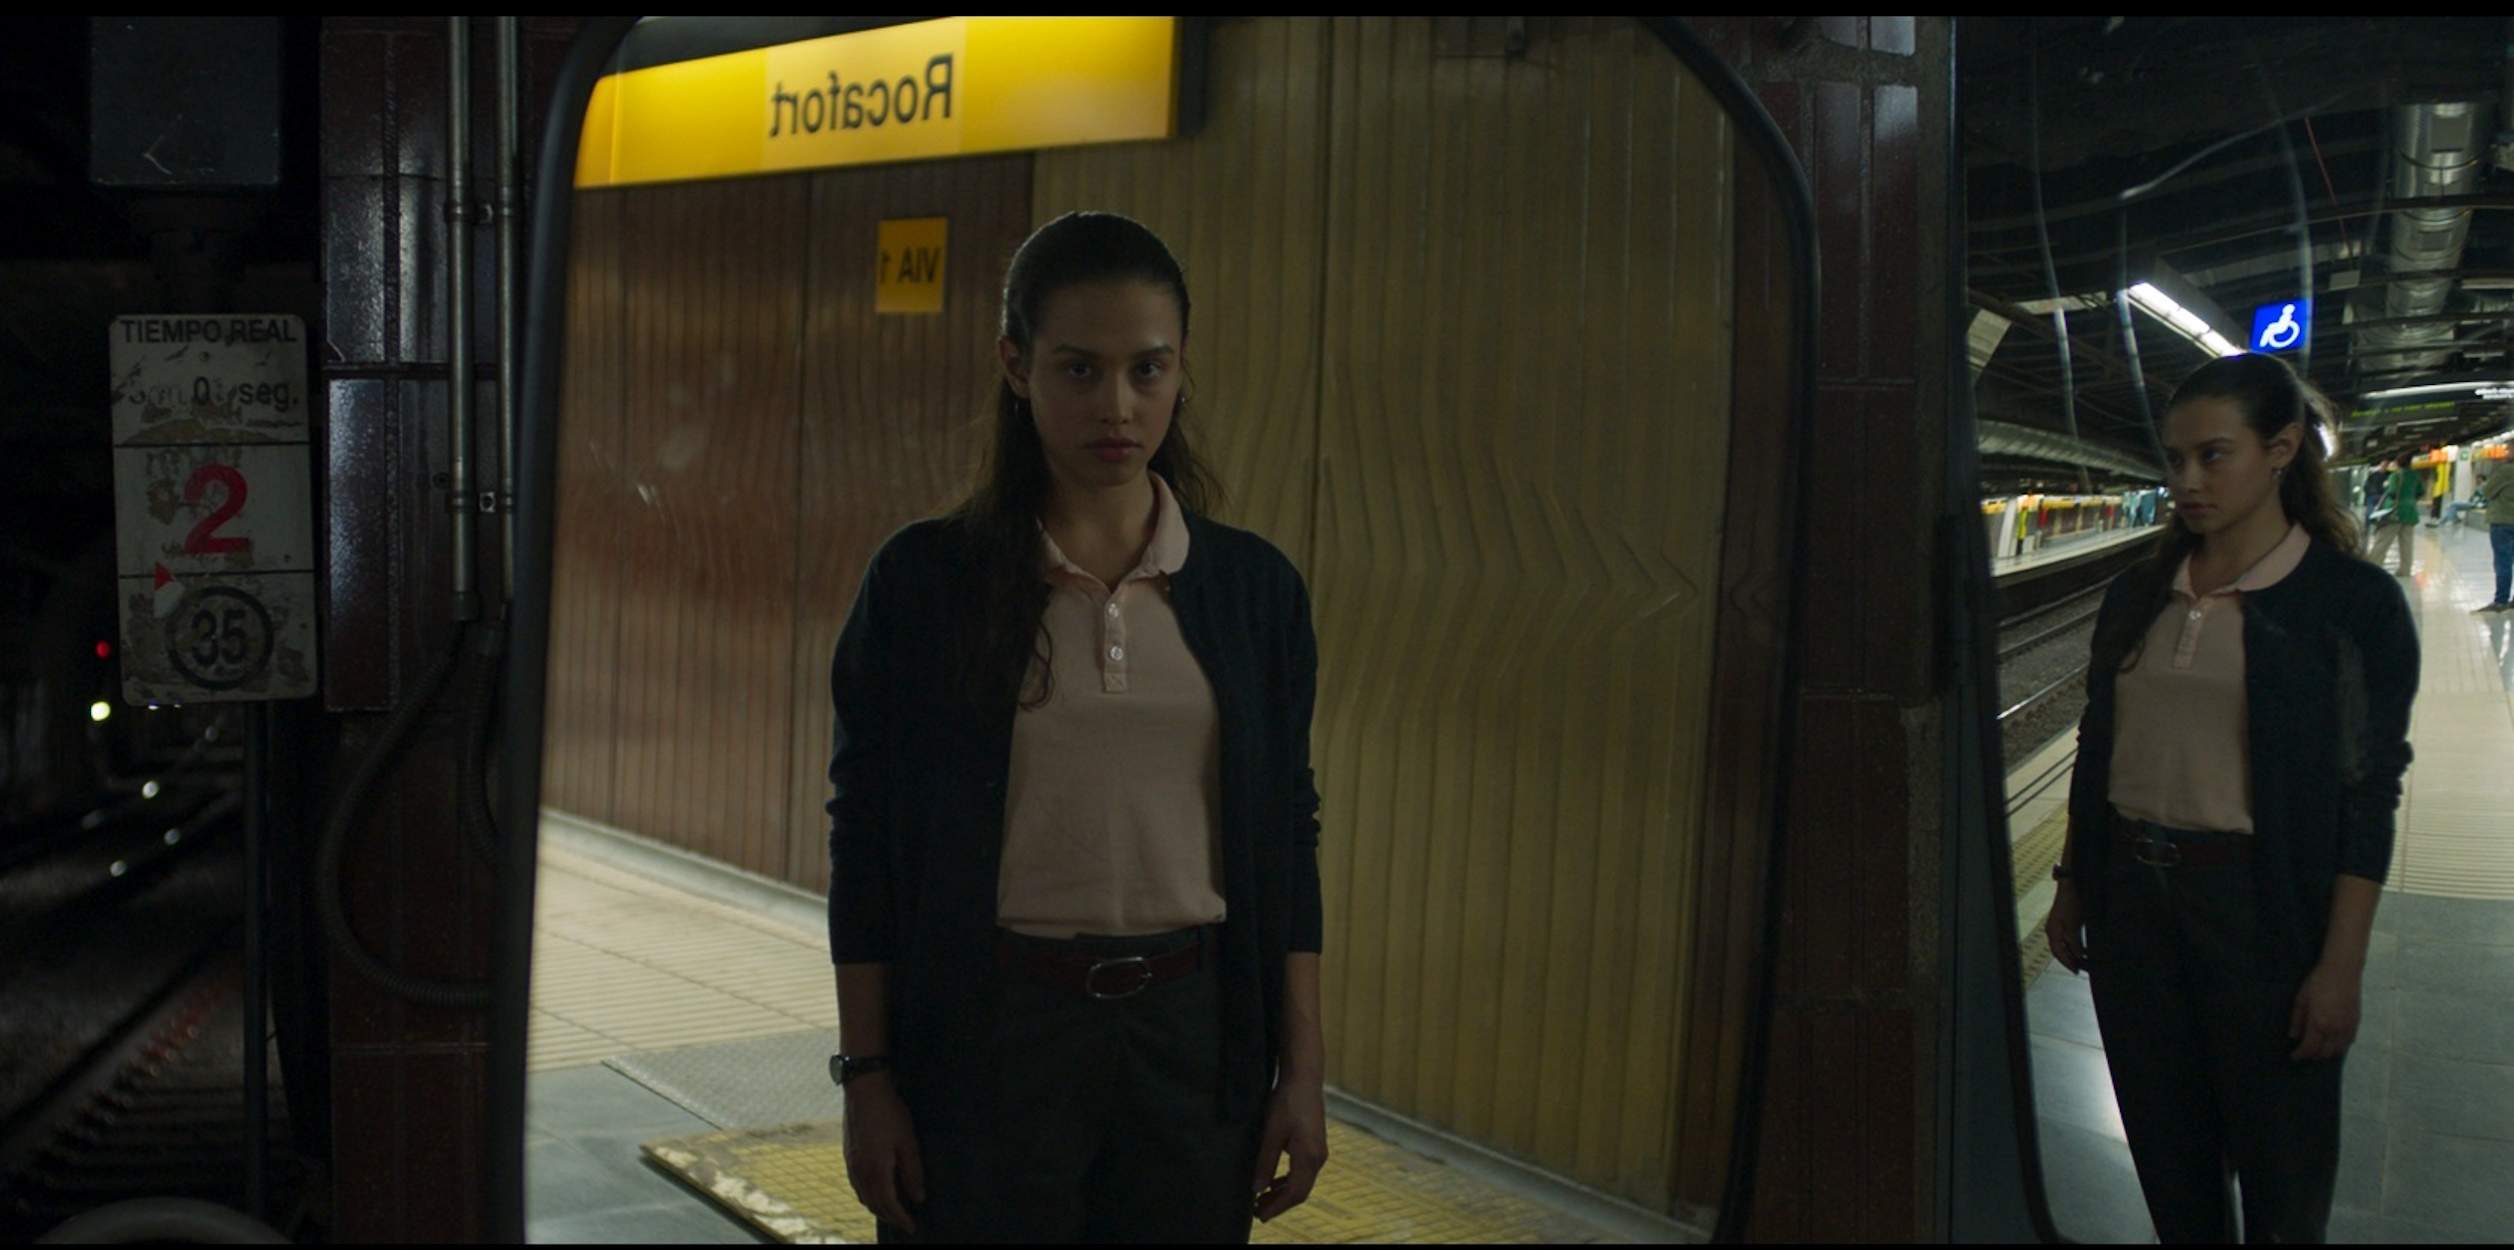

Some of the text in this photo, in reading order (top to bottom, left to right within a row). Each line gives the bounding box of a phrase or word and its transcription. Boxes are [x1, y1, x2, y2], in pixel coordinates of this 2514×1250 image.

[120, 319, 297, 343] TIEMPO REAL
[238, 382, 299, 413] seg.
[184, 464, 250, 554] 2
[190, 607, 247, 668] 35
